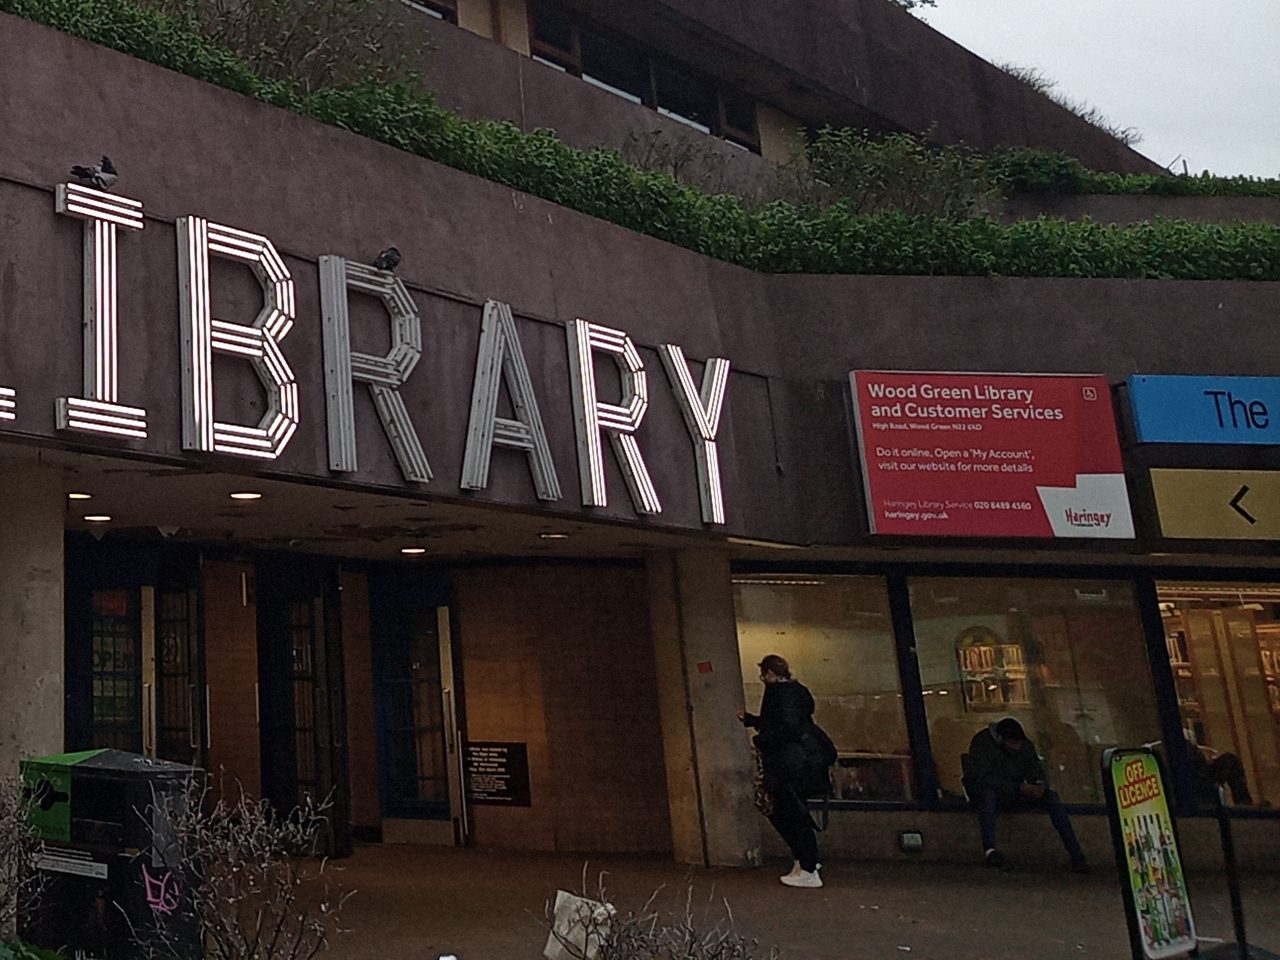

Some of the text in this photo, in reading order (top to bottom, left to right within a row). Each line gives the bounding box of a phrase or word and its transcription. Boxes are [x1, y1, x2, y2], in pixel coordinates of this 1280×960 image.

[868, 384, 1033, 403] Wood Green Library
[871, 403, 1064, 420] and Customer Services
[1204, 390, 1269, 429] The
[872, 422, 889, 430] High
[876, 447, 890, 457] Do
[892, 448, 900, 457] it
[935, 448, 962, 459] Open
[878, 462, 898, 470] visit
[918, 462, 956, 471] website
[957, 463, 972, 472] for
[1000, 463, 1033, 473] details
[1065, 507, 1111, 527] Haringey
[1125, 761, 1145, 781] OFF
[1120, 777, 1159, 806] LICENCE
